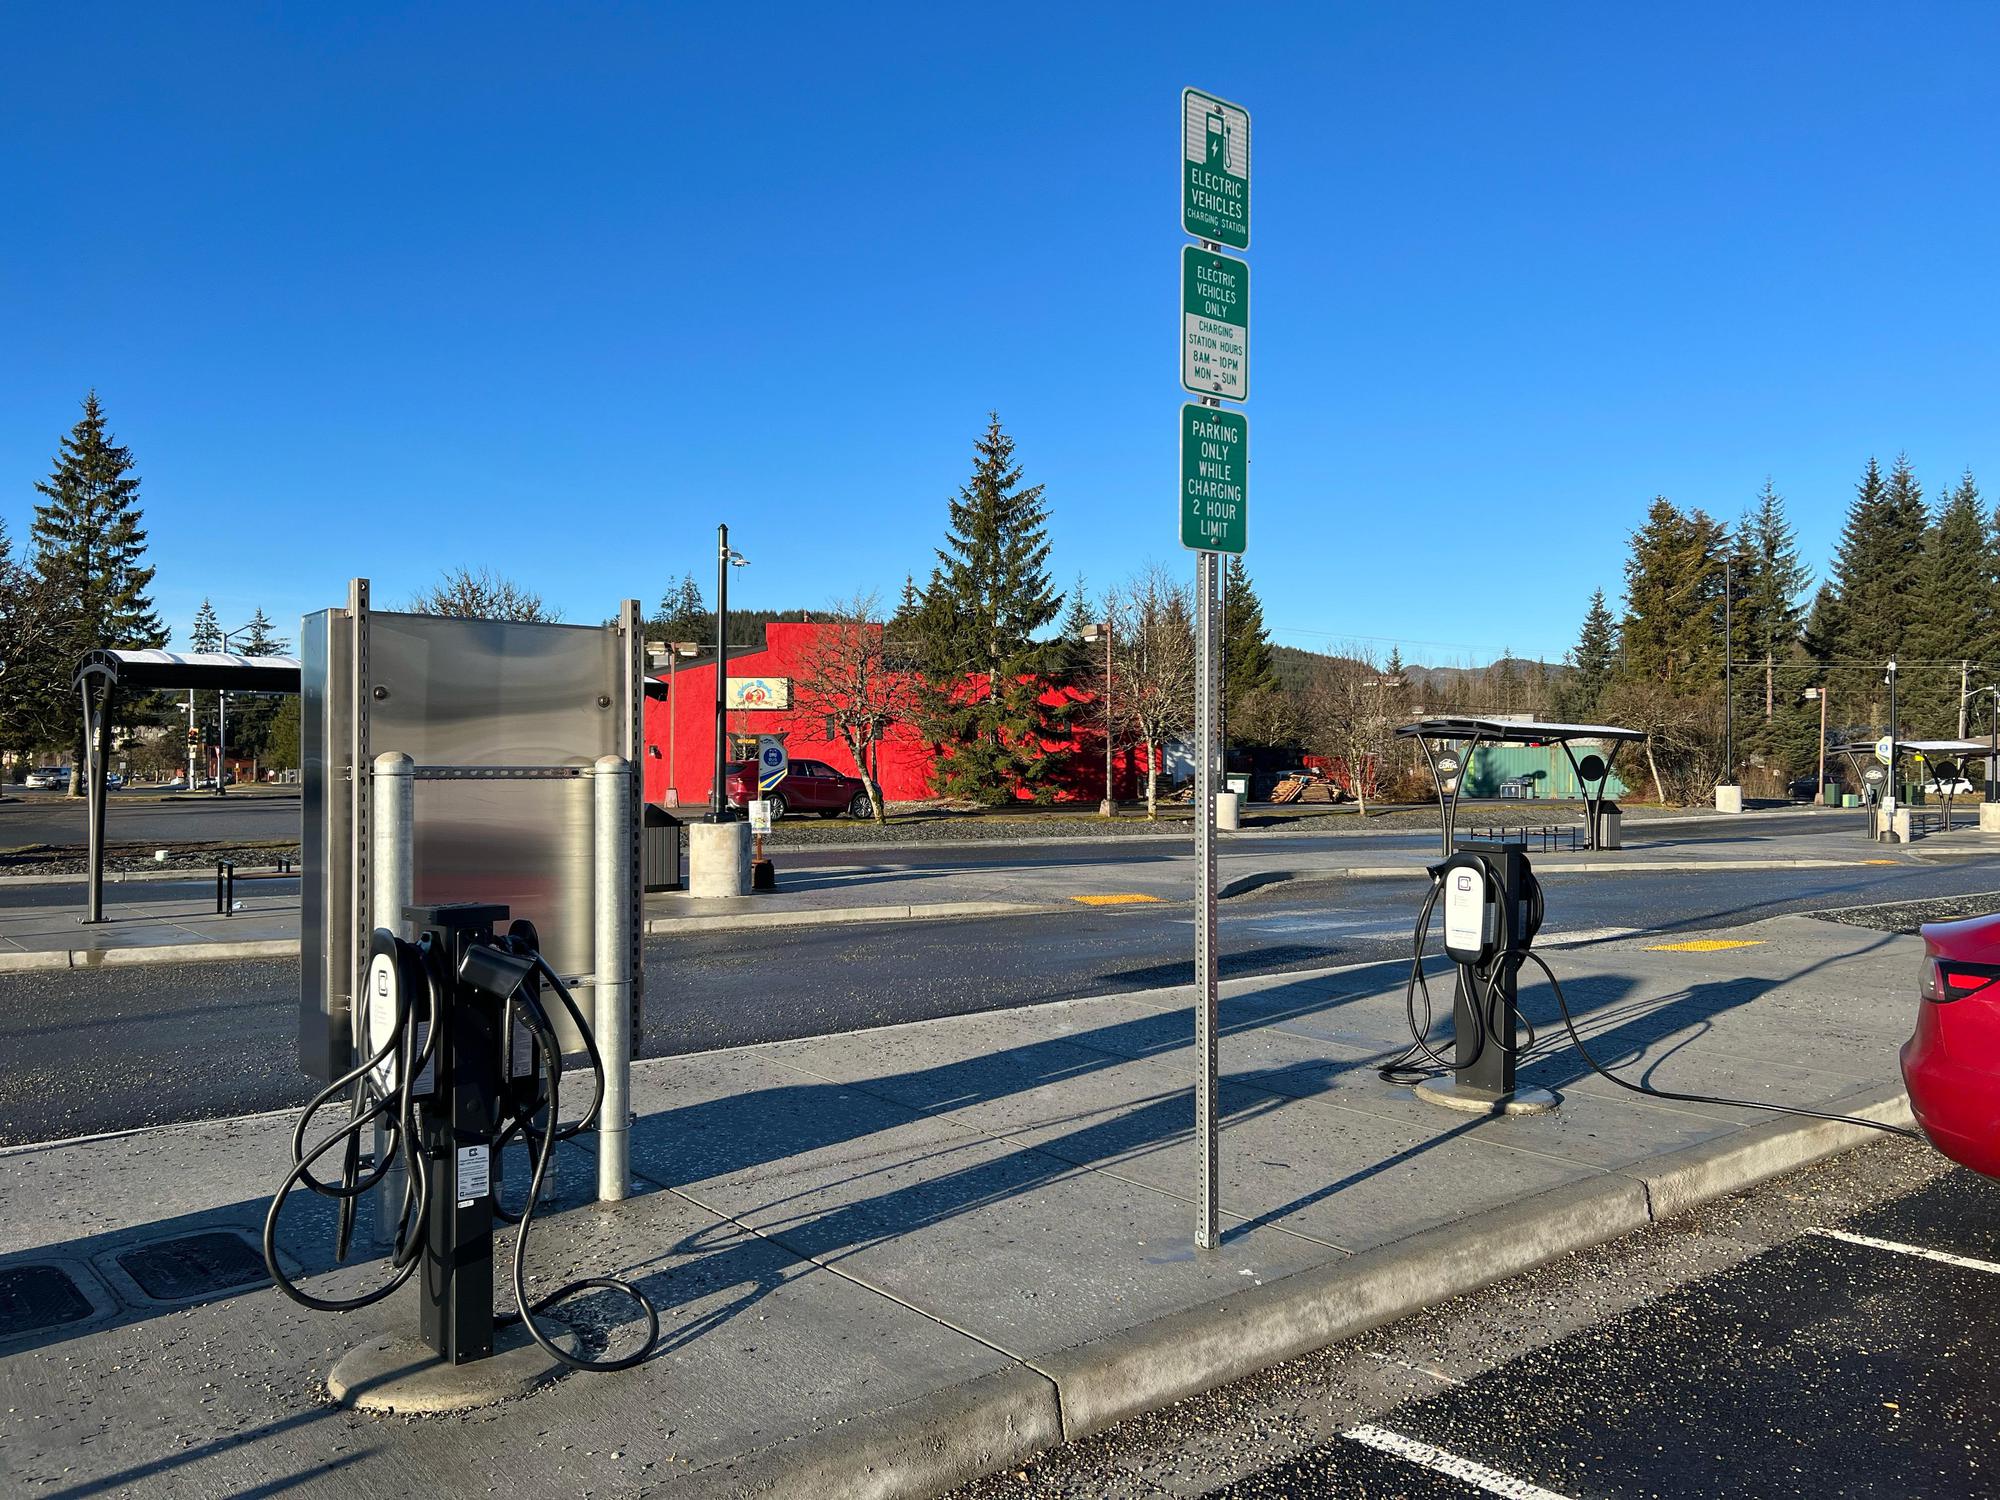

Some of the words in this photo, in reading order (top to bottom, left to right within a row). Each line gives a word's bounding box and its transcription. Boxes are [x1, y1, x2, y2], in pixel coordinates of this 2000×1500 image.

[1192, 167, 1242, 199] ELECTRIC
[1191, 188, 1242, 219] VEHICLES
[1187, 207, 1219, 226] CHARGING
[1221, 219, 1246, 234] STATION
[1197, 266, 1236, 288] ELECTRIC
[1197, 282, 1236, 305] VEHICLES
[1205, 301, 1227, 318] ONLY
[1199, 320, 1233, 339] CHARGING
[1189, 333, 1217, 350] STATION
[1220, 342, 1243, 356] HOURS
[1193, 351, 1210, 364] 8AM
[1220, 357, 1238, 370] 10PM
[1195, 366, 1211, 380] MON
[1222, 373, 1237, 386] SUN
[1192, 421, 1238, 443] PARKING
[1201, 441, 1229, 461] ONLY
[1199, 461, 1231, 481] WHILE
[1188, 478, 1241, 502] CHARGING
[1193, 499, 1200, 515] 2
[1207, 501, 1236, 520] HOUR
[1201, 520, 1228, 538] LIMIT
